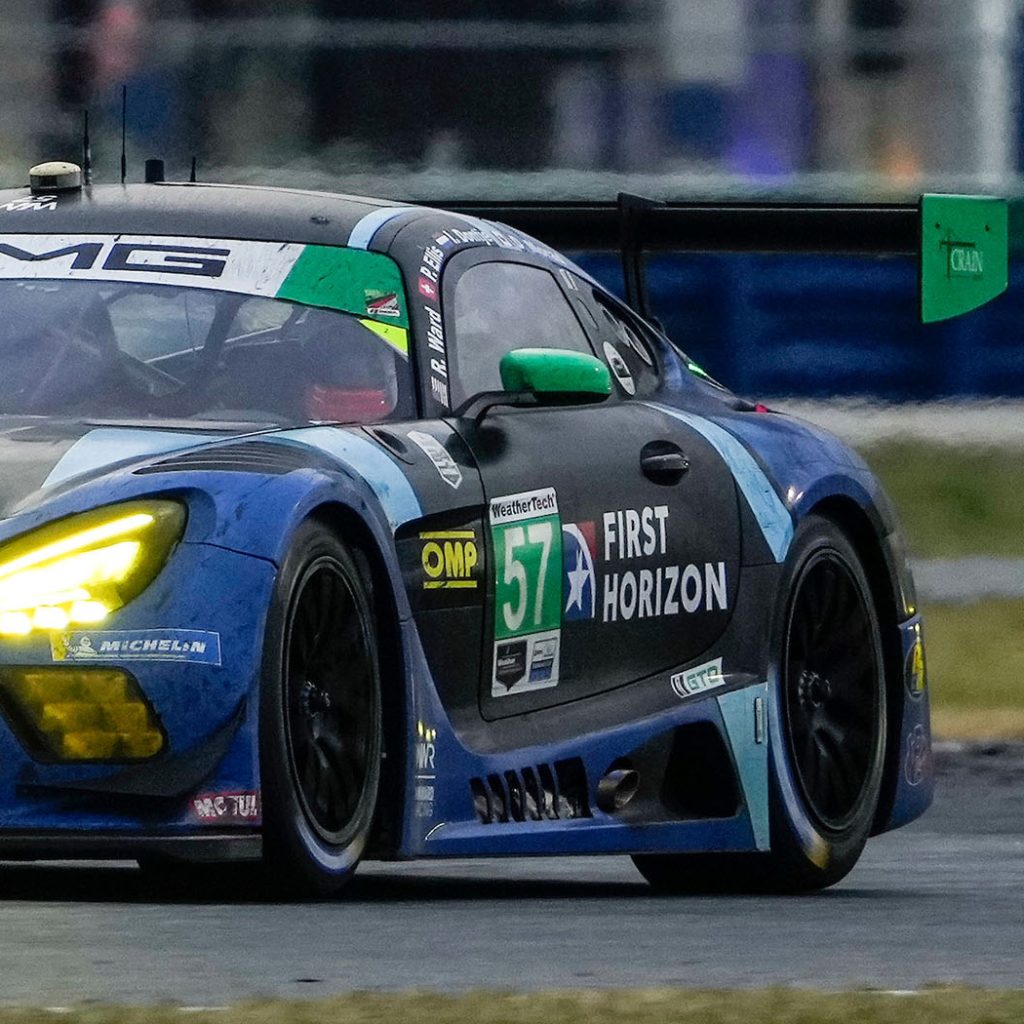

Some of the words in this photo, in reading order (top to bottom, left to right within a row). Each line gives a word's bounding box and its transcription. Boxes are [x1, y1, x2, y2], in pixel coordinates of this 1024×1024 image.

[424, 305, 445, 354] Ward
[430, 358, 448, 378] R.
[491, 493, 555, 519] WeatherTech
[602, 504, 670, 561] FIRST
[421, 540, 478, 579] OMP
[502, 522, 553, 632] 57
[602, 561, 728, 623] HORIZON
